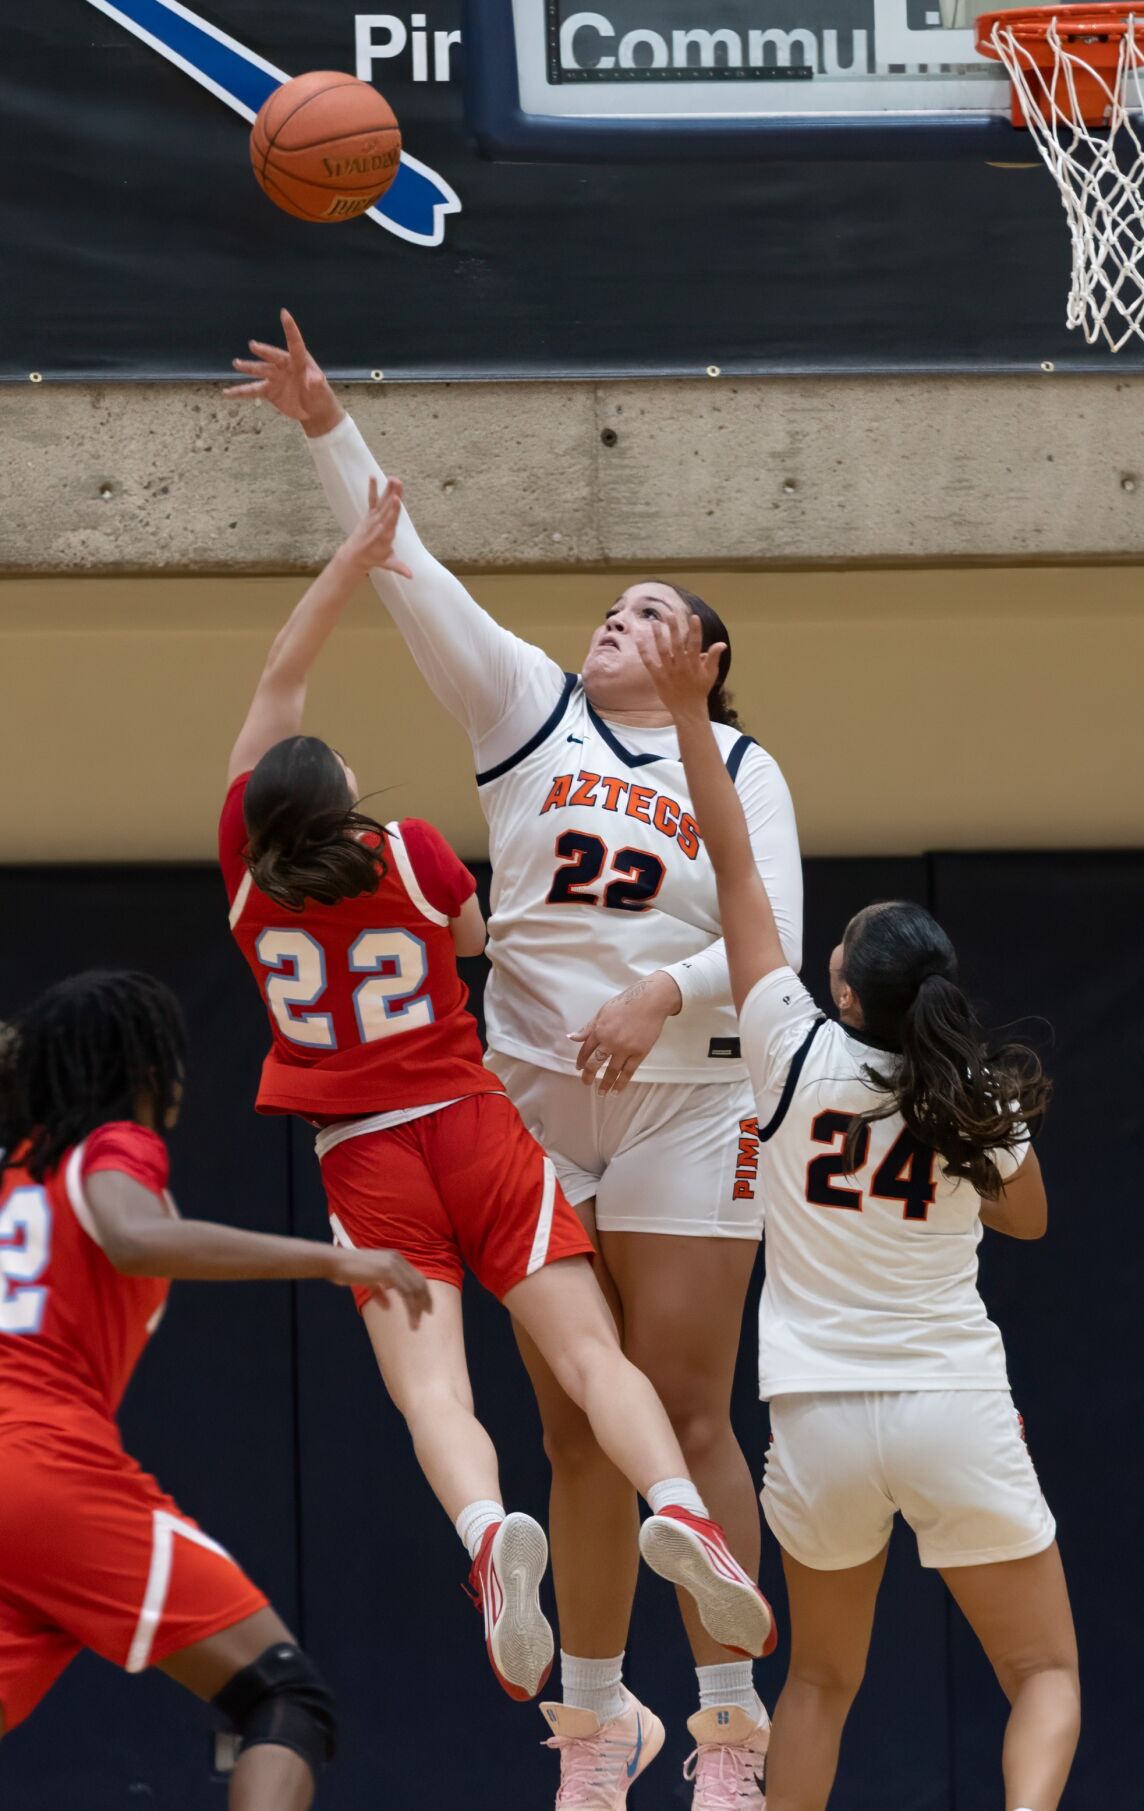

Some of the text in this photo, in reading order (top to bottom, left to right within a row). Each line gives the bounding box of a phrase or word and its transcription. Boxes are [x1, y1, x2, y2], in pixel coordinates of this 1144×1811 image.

[539, 769, 702, 860] AZTECS
[546, 829, 666, 912] 22
[255, 927, 434, 1049] 22
[732, 1116, 760, 1202] PIMA
[805, 1108, 938, 1221] 24
